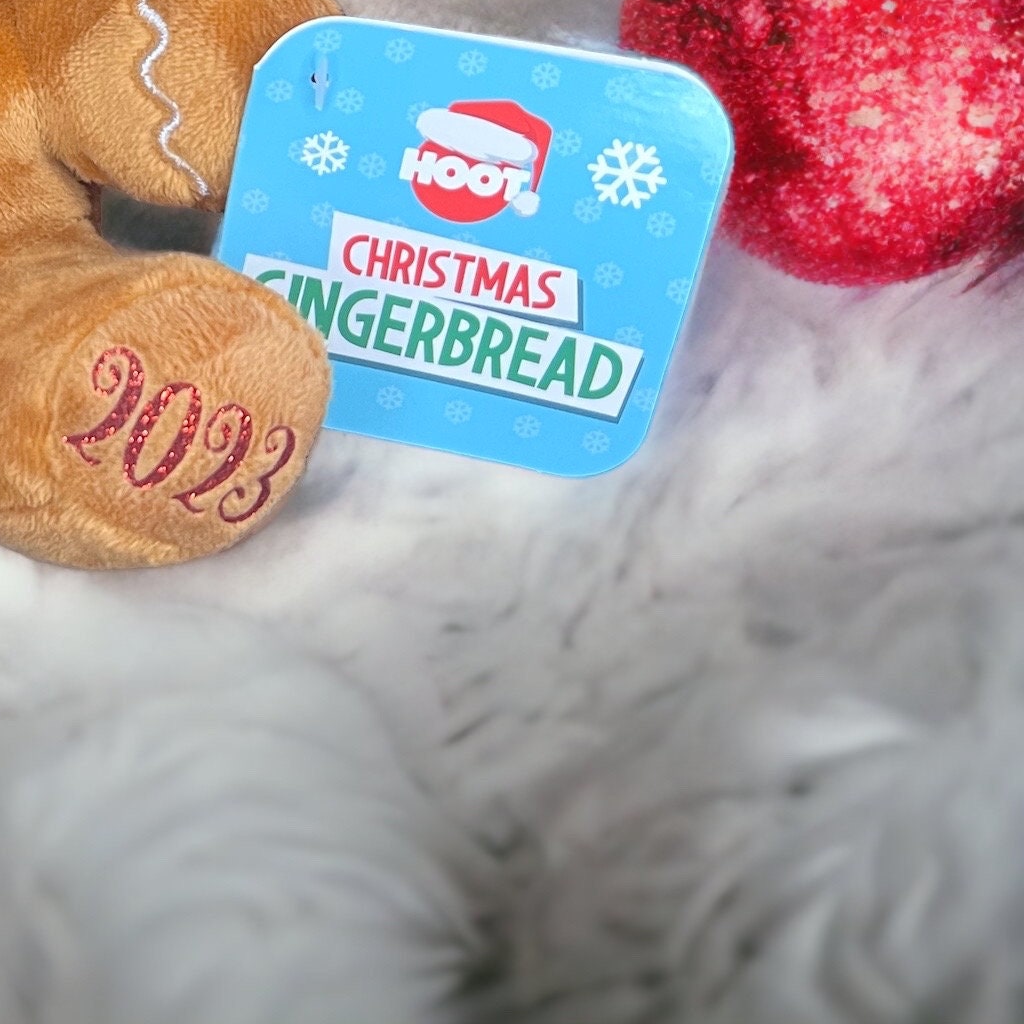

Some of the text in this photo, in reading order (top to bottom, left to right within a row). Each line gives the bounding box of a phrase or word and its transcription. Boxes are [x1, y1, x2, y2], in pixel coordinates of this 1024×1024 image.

[399, 147, 531, 202] HOOT
[342, 234, 562, 310] CHRISTMAS
[255, 269, 623, 400] INGERBREAD
[62, 346, 296, 523] 2023
